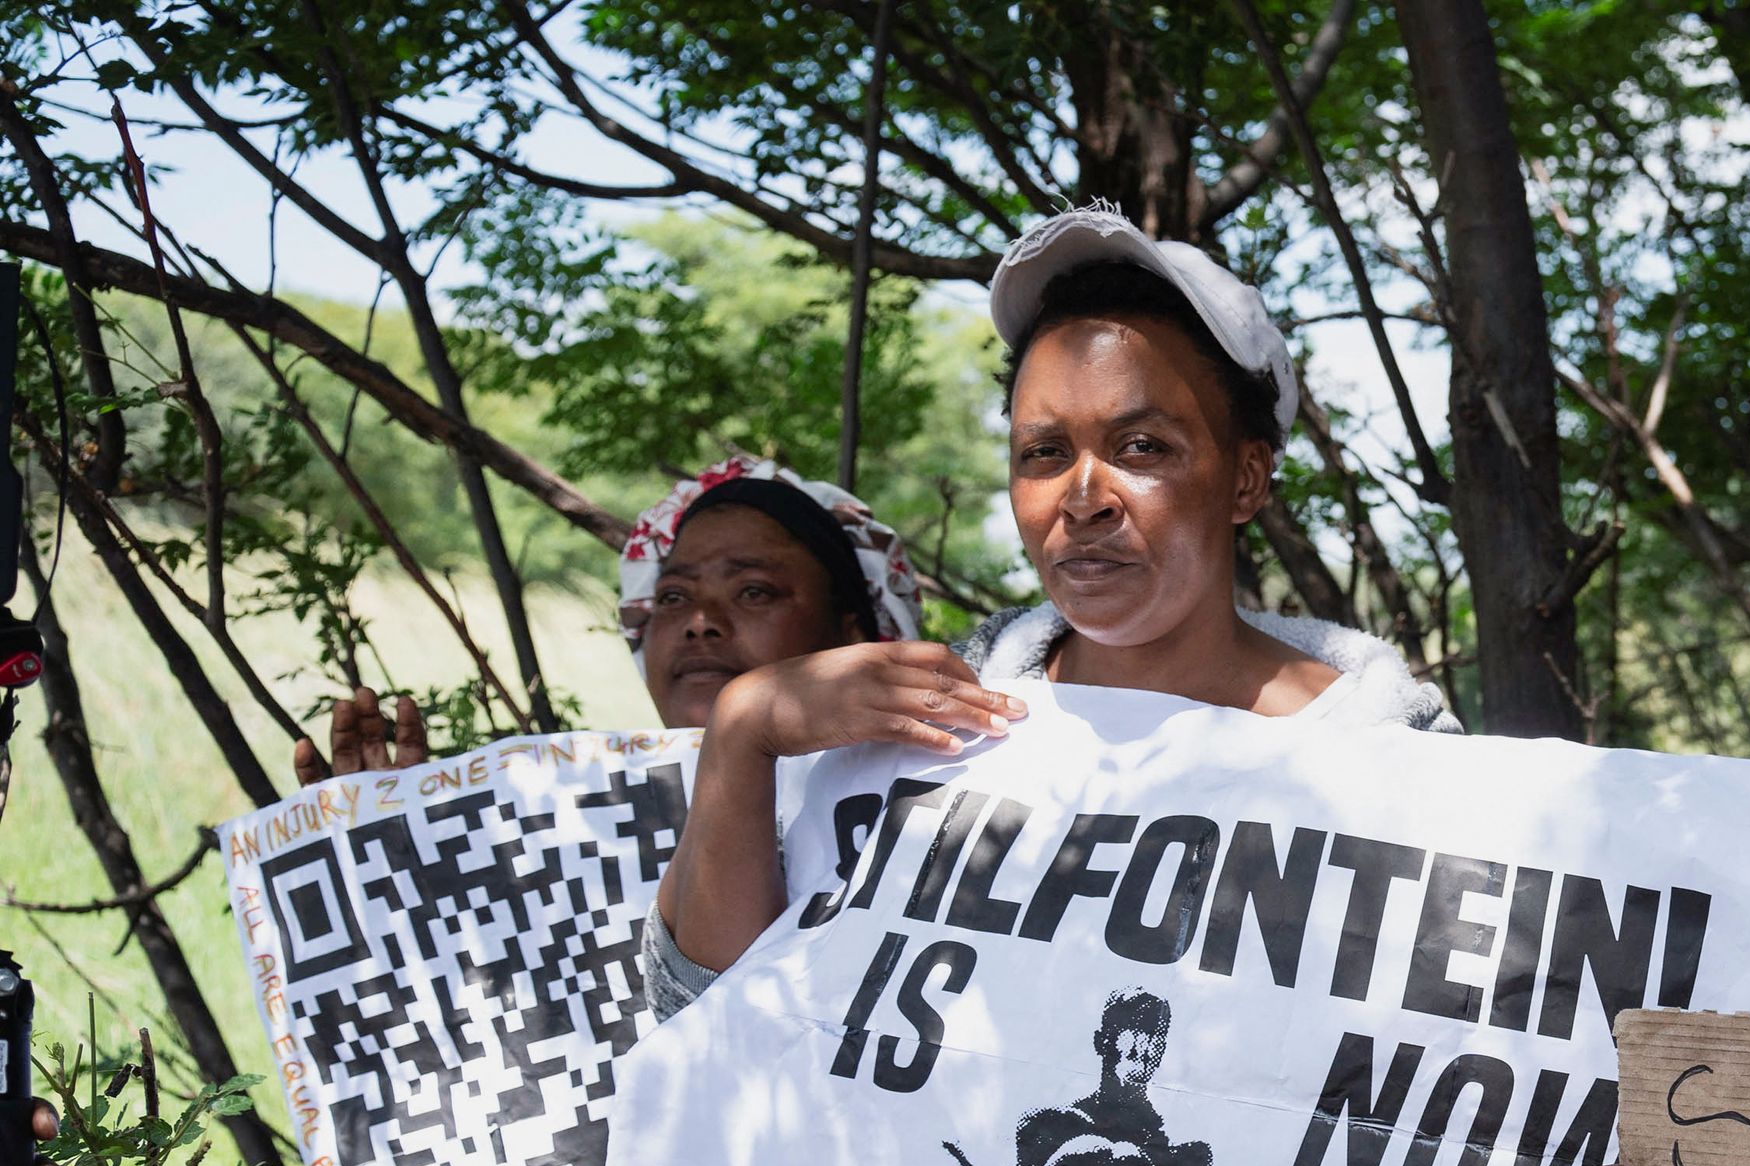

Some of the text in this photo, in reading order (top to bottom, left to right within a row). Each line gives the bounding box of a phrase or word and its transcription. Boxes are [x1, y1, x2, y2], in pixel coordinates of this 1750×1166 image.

[229, 825, 261, 868] AN
[418, 755, 490, 797] ONE
[237, 886, 264, 945] ALL
[253, 953, 287, 1025] ARE
[271, 1032, 320, 1149] EQUAL
[829, 931, 978, 1094] IS
